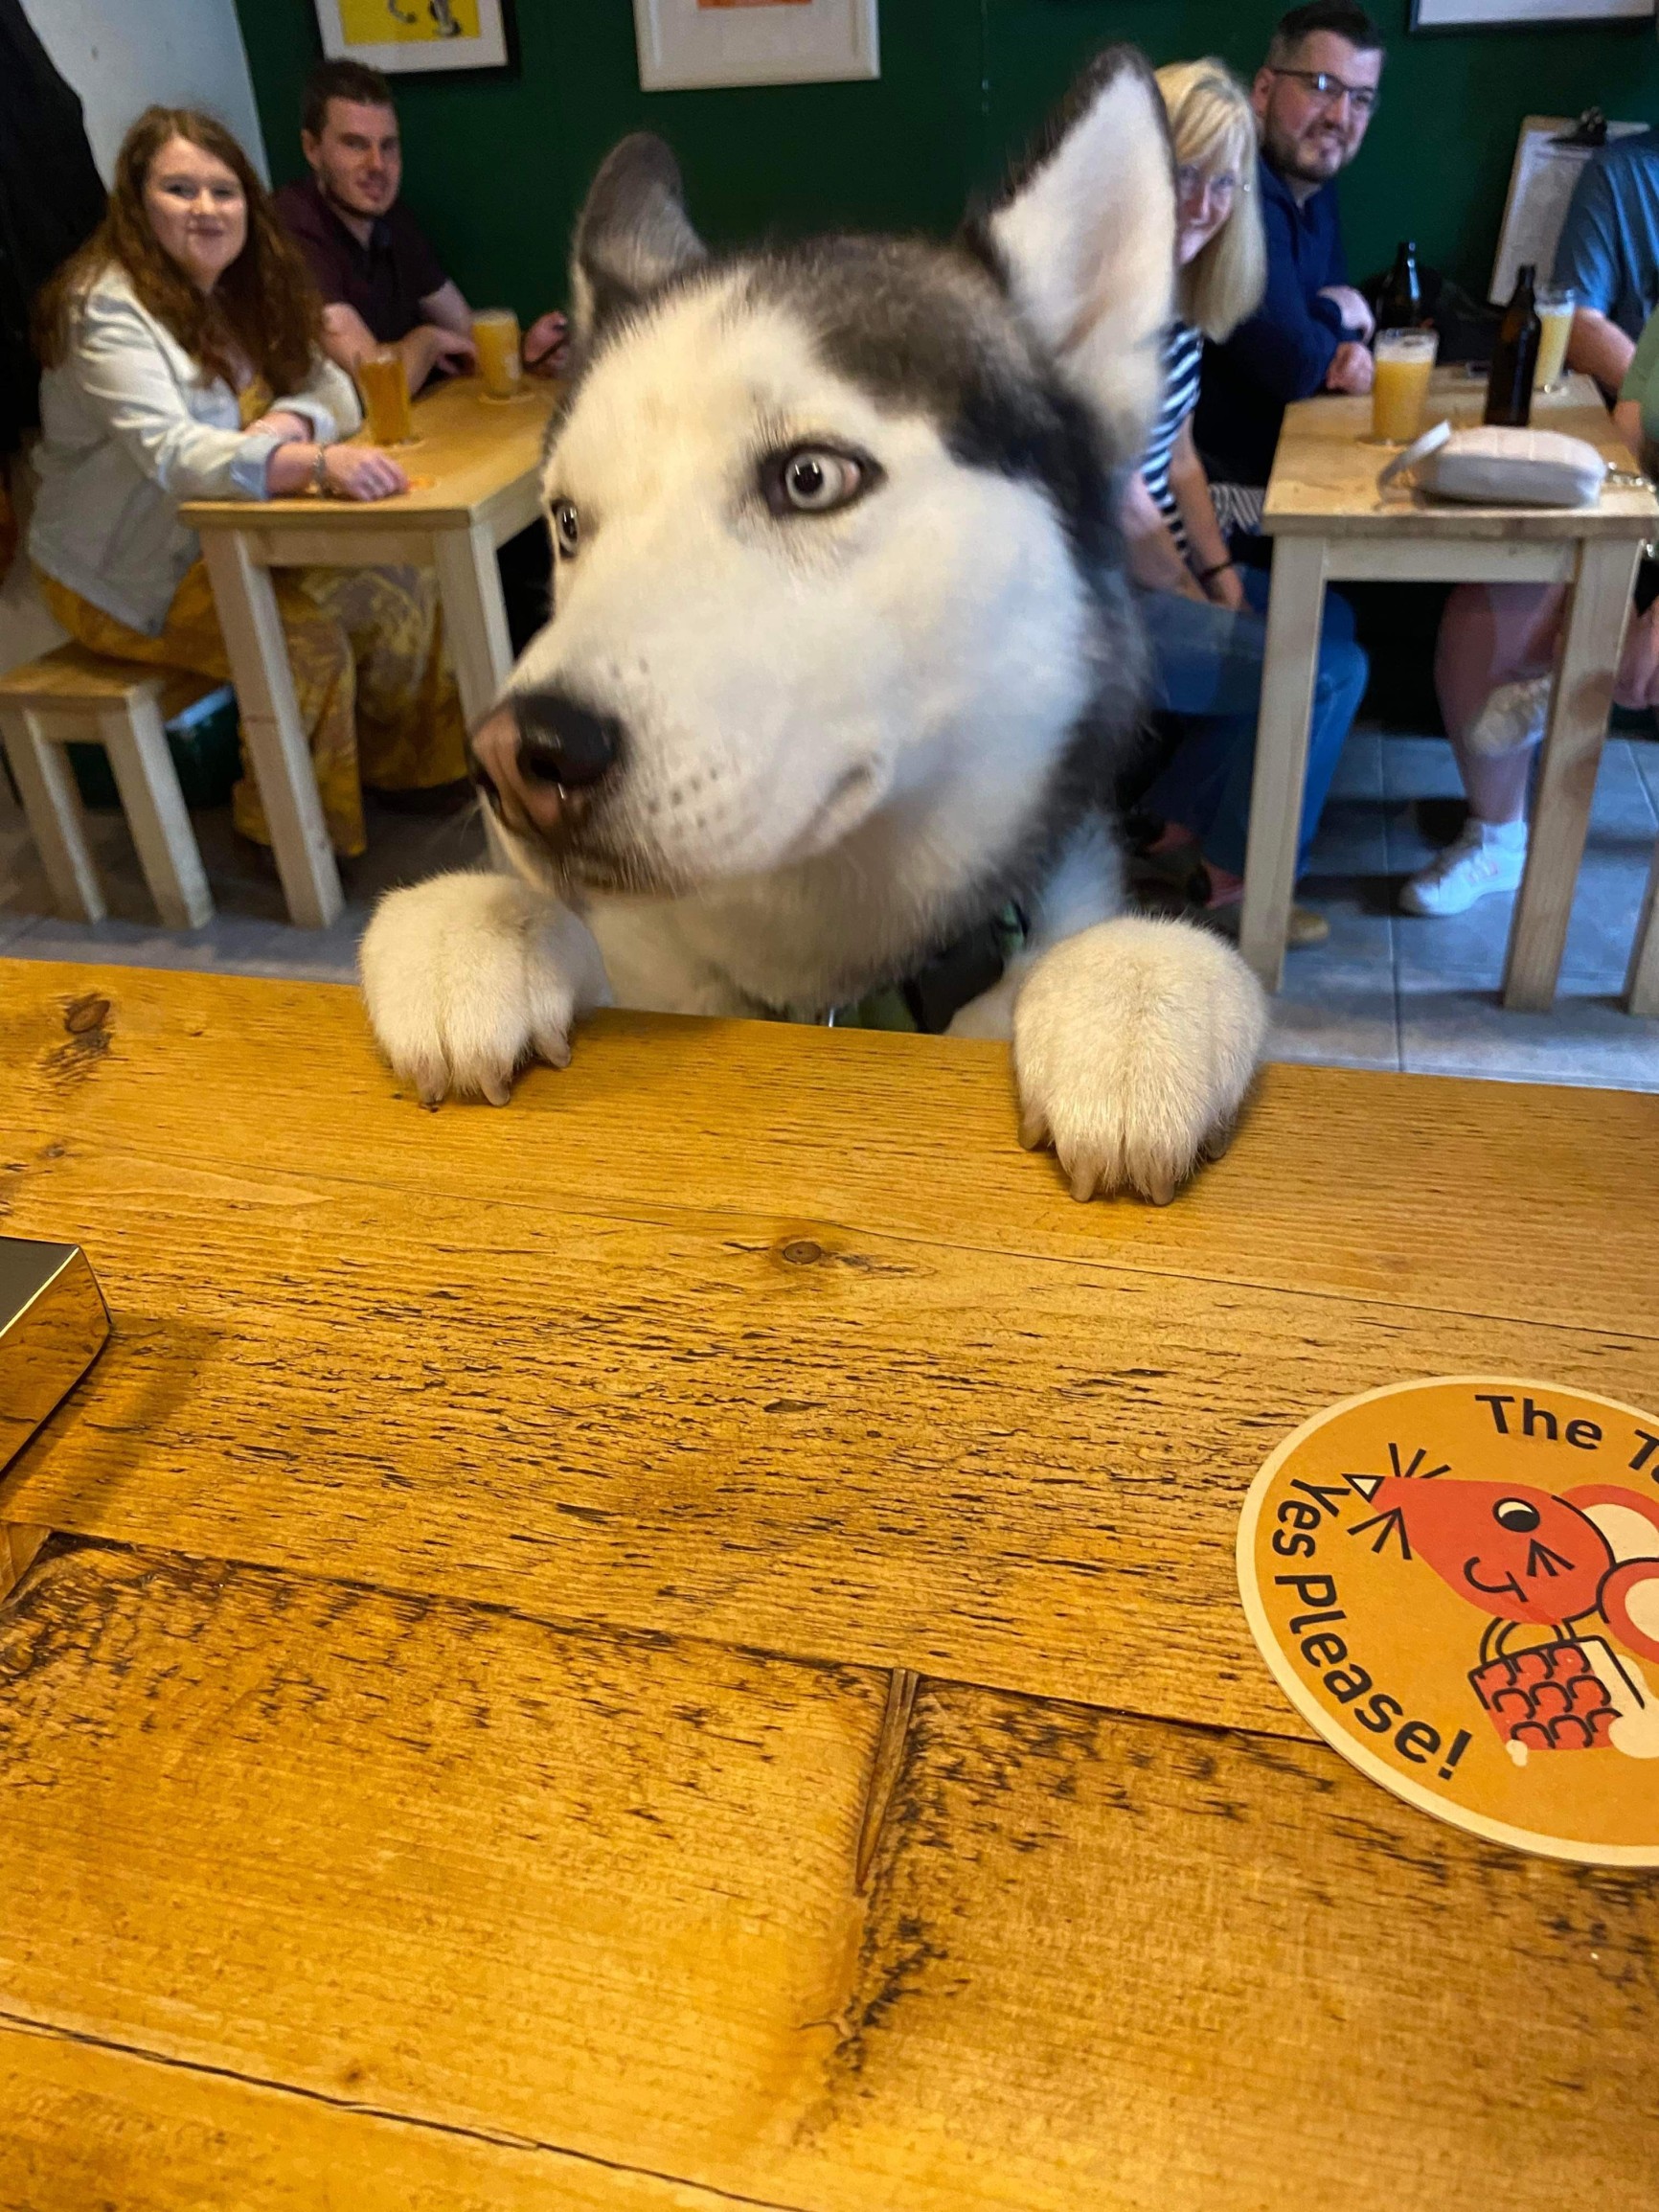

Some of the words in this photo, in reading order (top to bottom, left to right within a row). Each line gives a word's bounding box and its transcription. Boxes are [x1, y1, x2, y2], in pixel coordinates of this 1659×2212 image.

[1474, 1394, 1603, 1450] The
[1628, 1428, 1659, 1486] T
[1272, 1478, 1352, 1558] Yes
[1274, 1575, 1473, 1781] Please!
